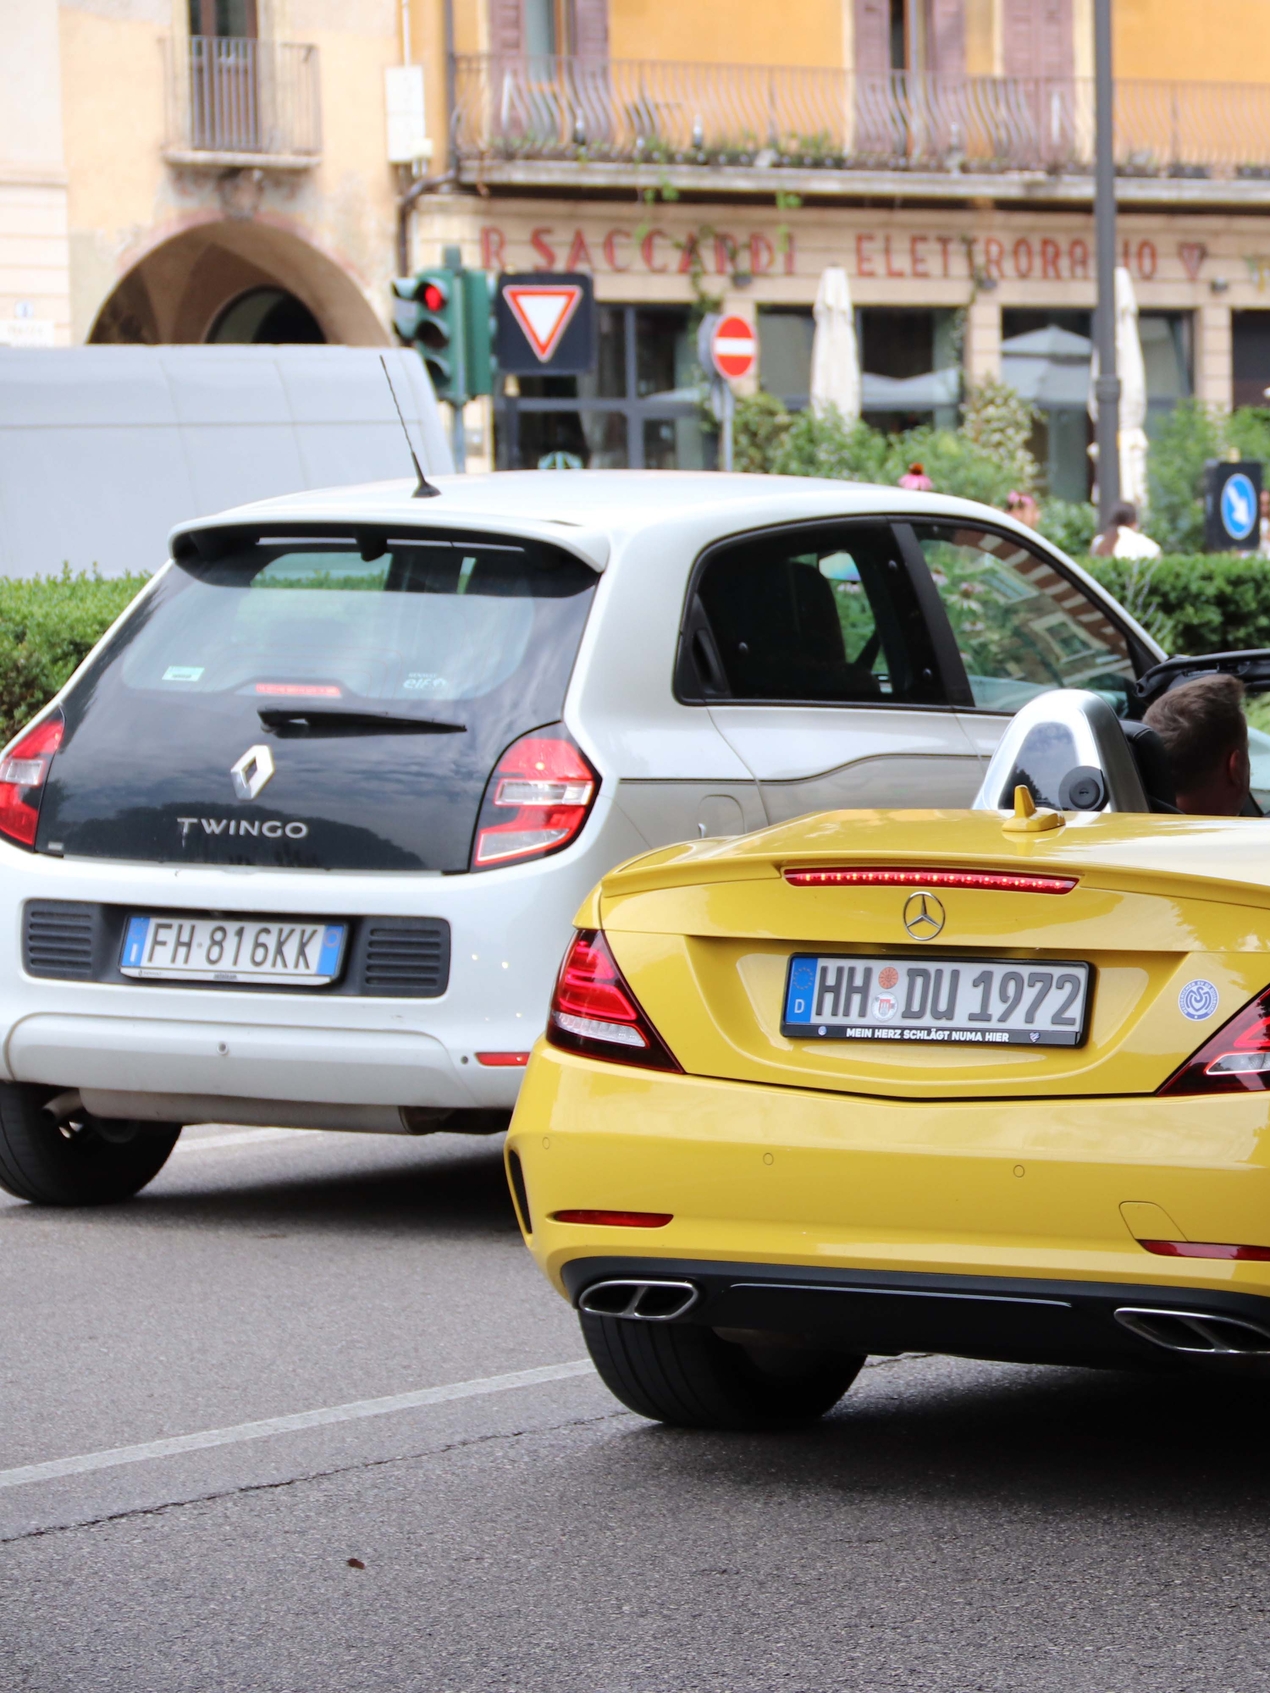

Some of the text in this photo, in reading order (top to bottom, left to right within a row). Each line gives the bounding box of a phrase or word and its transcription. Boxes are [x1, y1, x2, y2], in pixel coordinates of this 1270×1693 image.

[530, 227, 796, 275] SACCARDI
[855, 233, 1158, 281] ELETTRORAIO
[177, 817, 308, 839] TWINGO
[147, 923, 318, 970] FH 816KK
[794, 998, 805, 1013] D
[815, 965, 1081, 1026] HH DU 1972
[846, 1027, 1009, 1042] MEIN HERZ SCHLÄGT NUMA HIER
